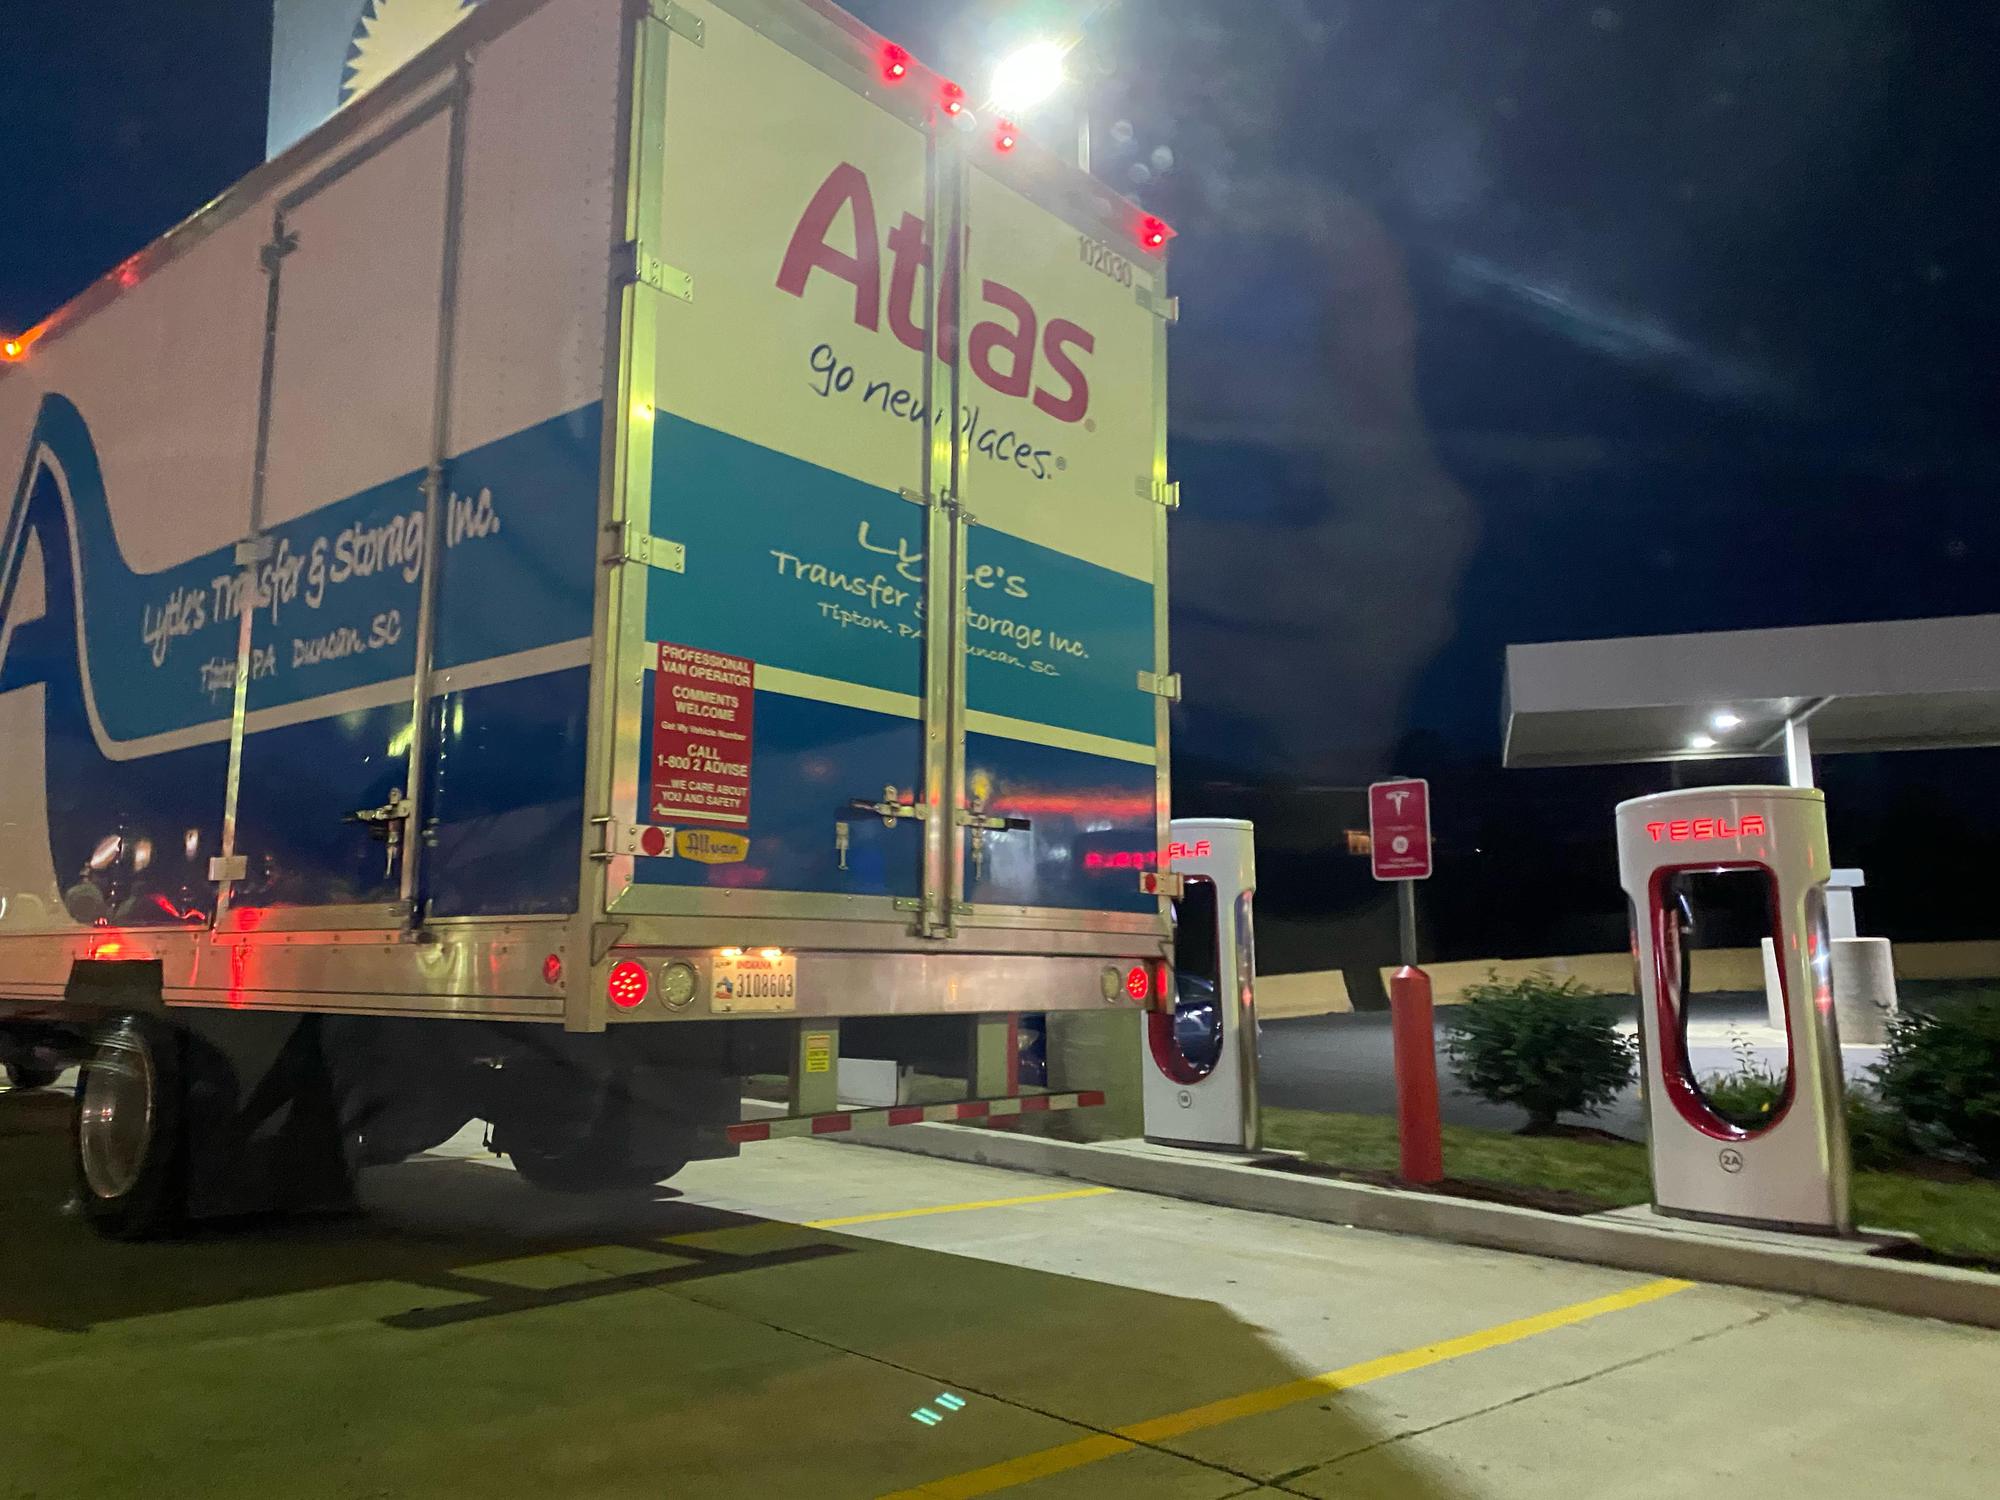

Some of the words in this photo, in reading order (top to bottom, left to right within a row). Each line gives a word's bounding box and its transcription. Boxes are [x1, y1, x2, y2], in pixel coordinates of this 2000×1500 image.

[776, 161, 1095, 423] Atlas
[809, 343, 854, 397] go
[330, 511, 425, 584] Storag
[858, 520, 1029, 599] Lye's
[770, 549, 909, 609] Transfer
[964, 606, 1043, 649] torage
[1049, 631, 1090, 660] Inc.
[662, 645, 751, 674] PROFESSIONAL
[662, 660, 688, 676] VAN
[688, 665, 751, 688] OPERATOR
[671, 685, 739, 709] COMMENTS
[675, 700, 736, 722] WELCOME
[687, 743, 721, 760] CALL
[657, 753, 691, 770] 1-800
[692, 758, 701, 771] 2
[703, 760, 748, 778] ADVISE
[662, 791, 682, 802] YOU
[683, 793, 705, 804] AND
[706, 795, 741, 808] SAFETY
[716, 785, 748, 797] ABOUT
[1646, 815, 1765, 842] TESLA
[736, 974, 793, 998] 3108603
[1722, 1155, 1741, 1165] 2A
